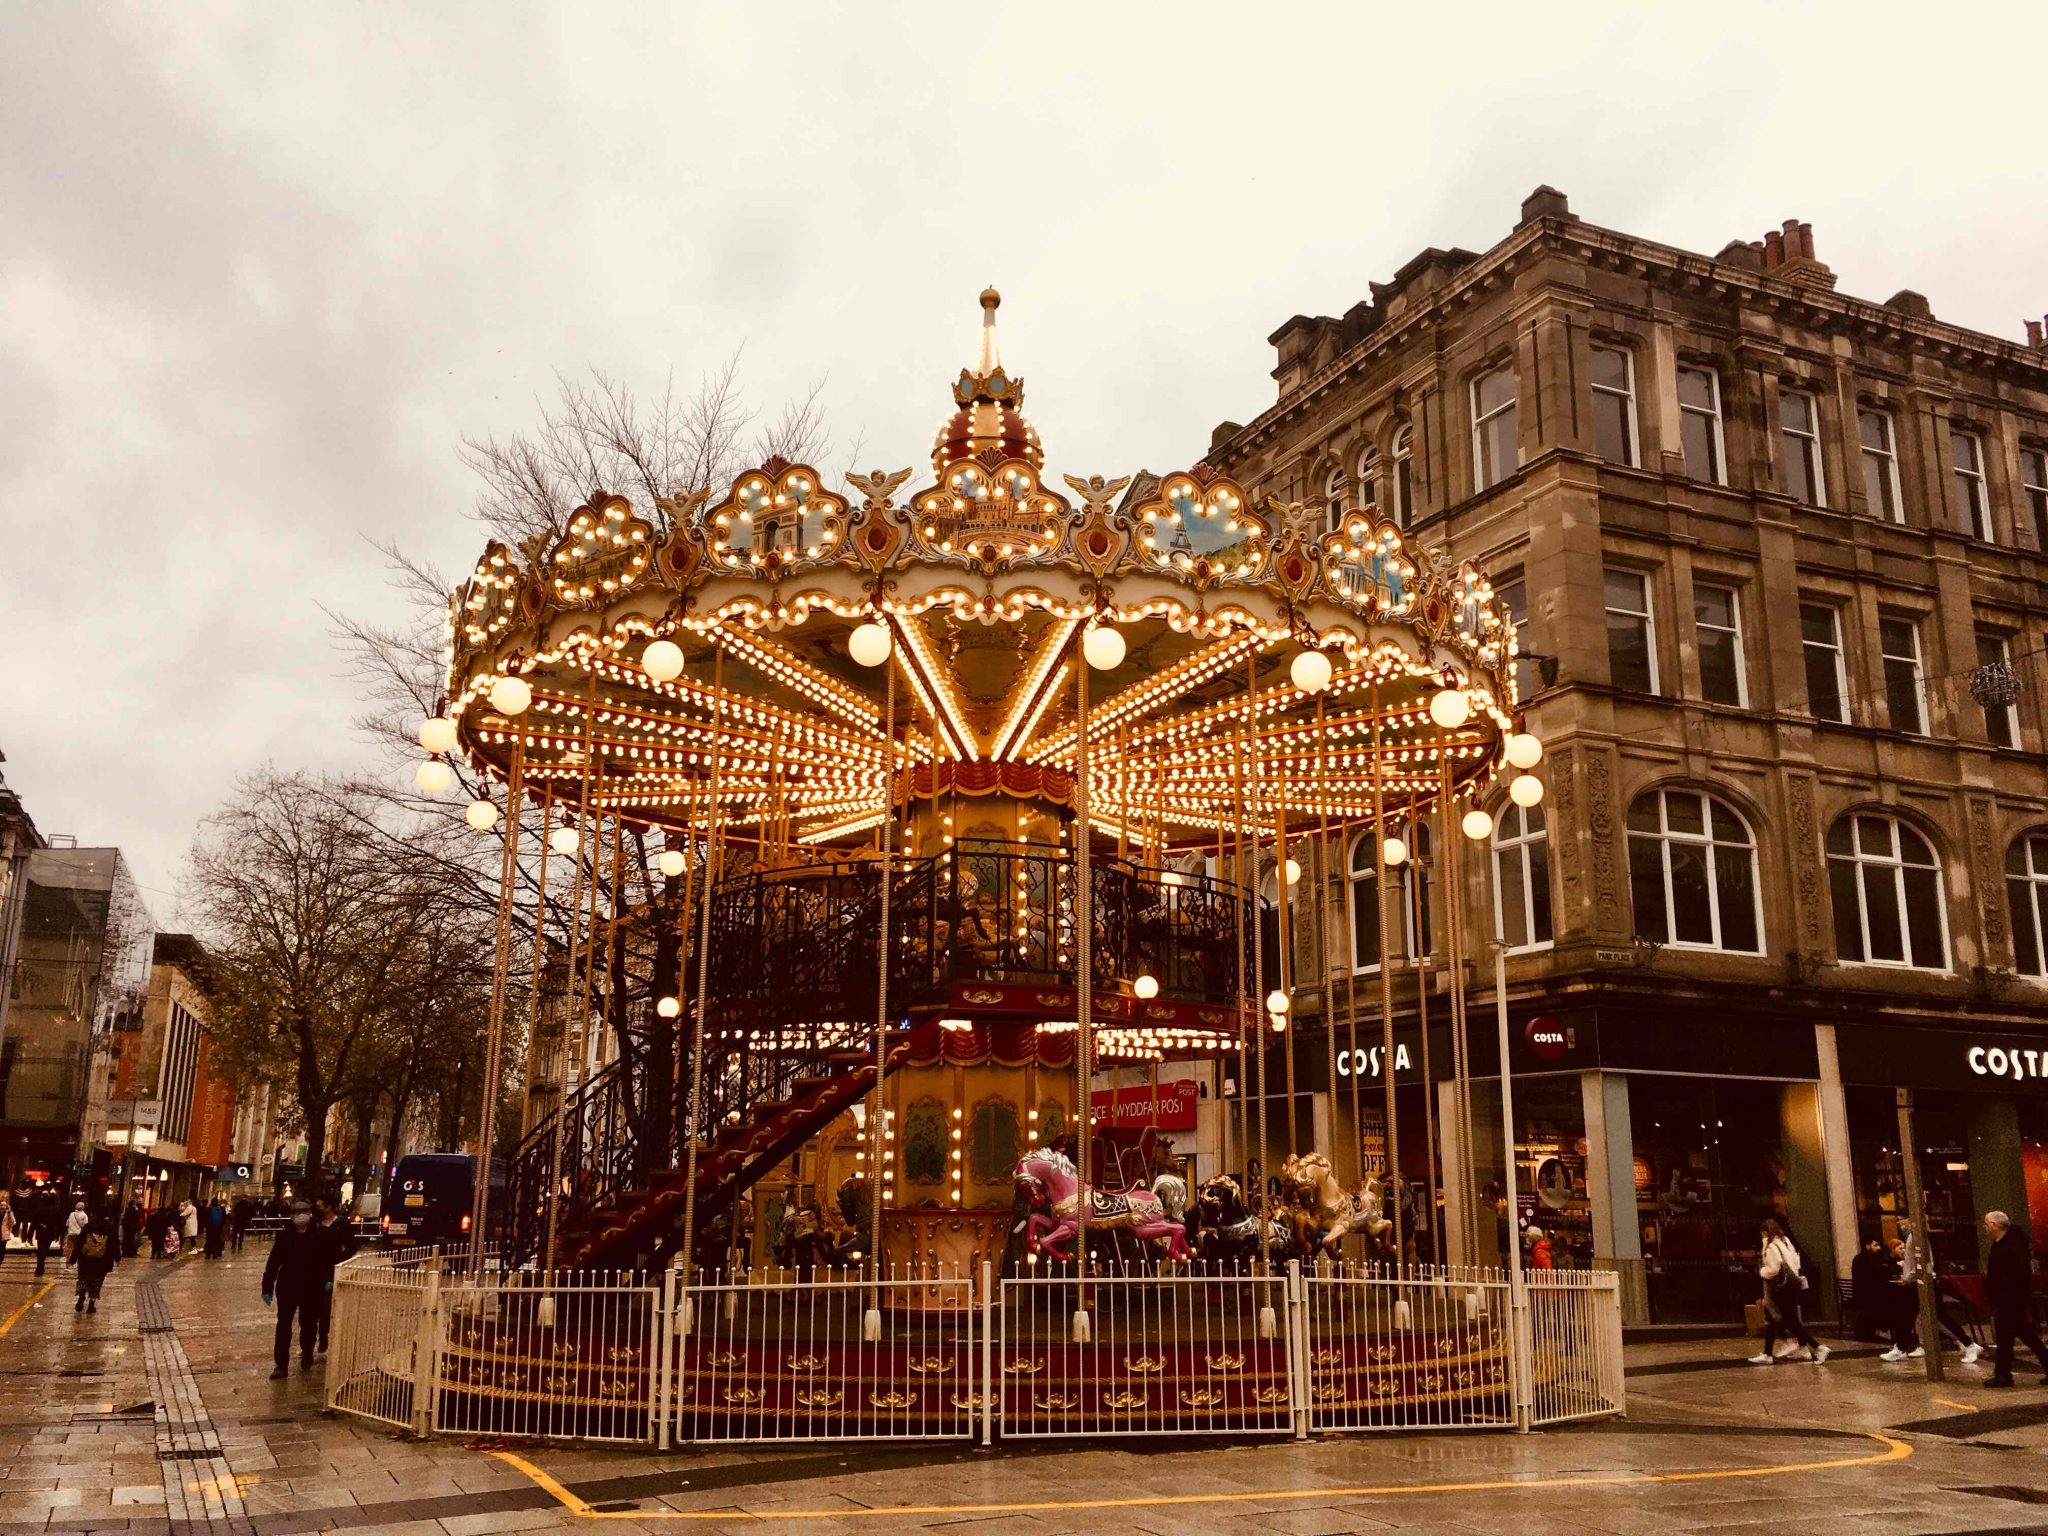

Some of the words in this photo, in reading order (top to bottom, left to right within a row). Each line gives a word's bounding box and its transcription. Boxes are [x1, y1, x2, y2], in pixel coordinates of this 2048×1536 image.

[1533, 1032, 1564, 1044] COSTA
[1337, 1044, 1412, 1077] COSA
[1178, 1088, 1196, 1097] POST
[140, 1107, 157, 1115] M&S
